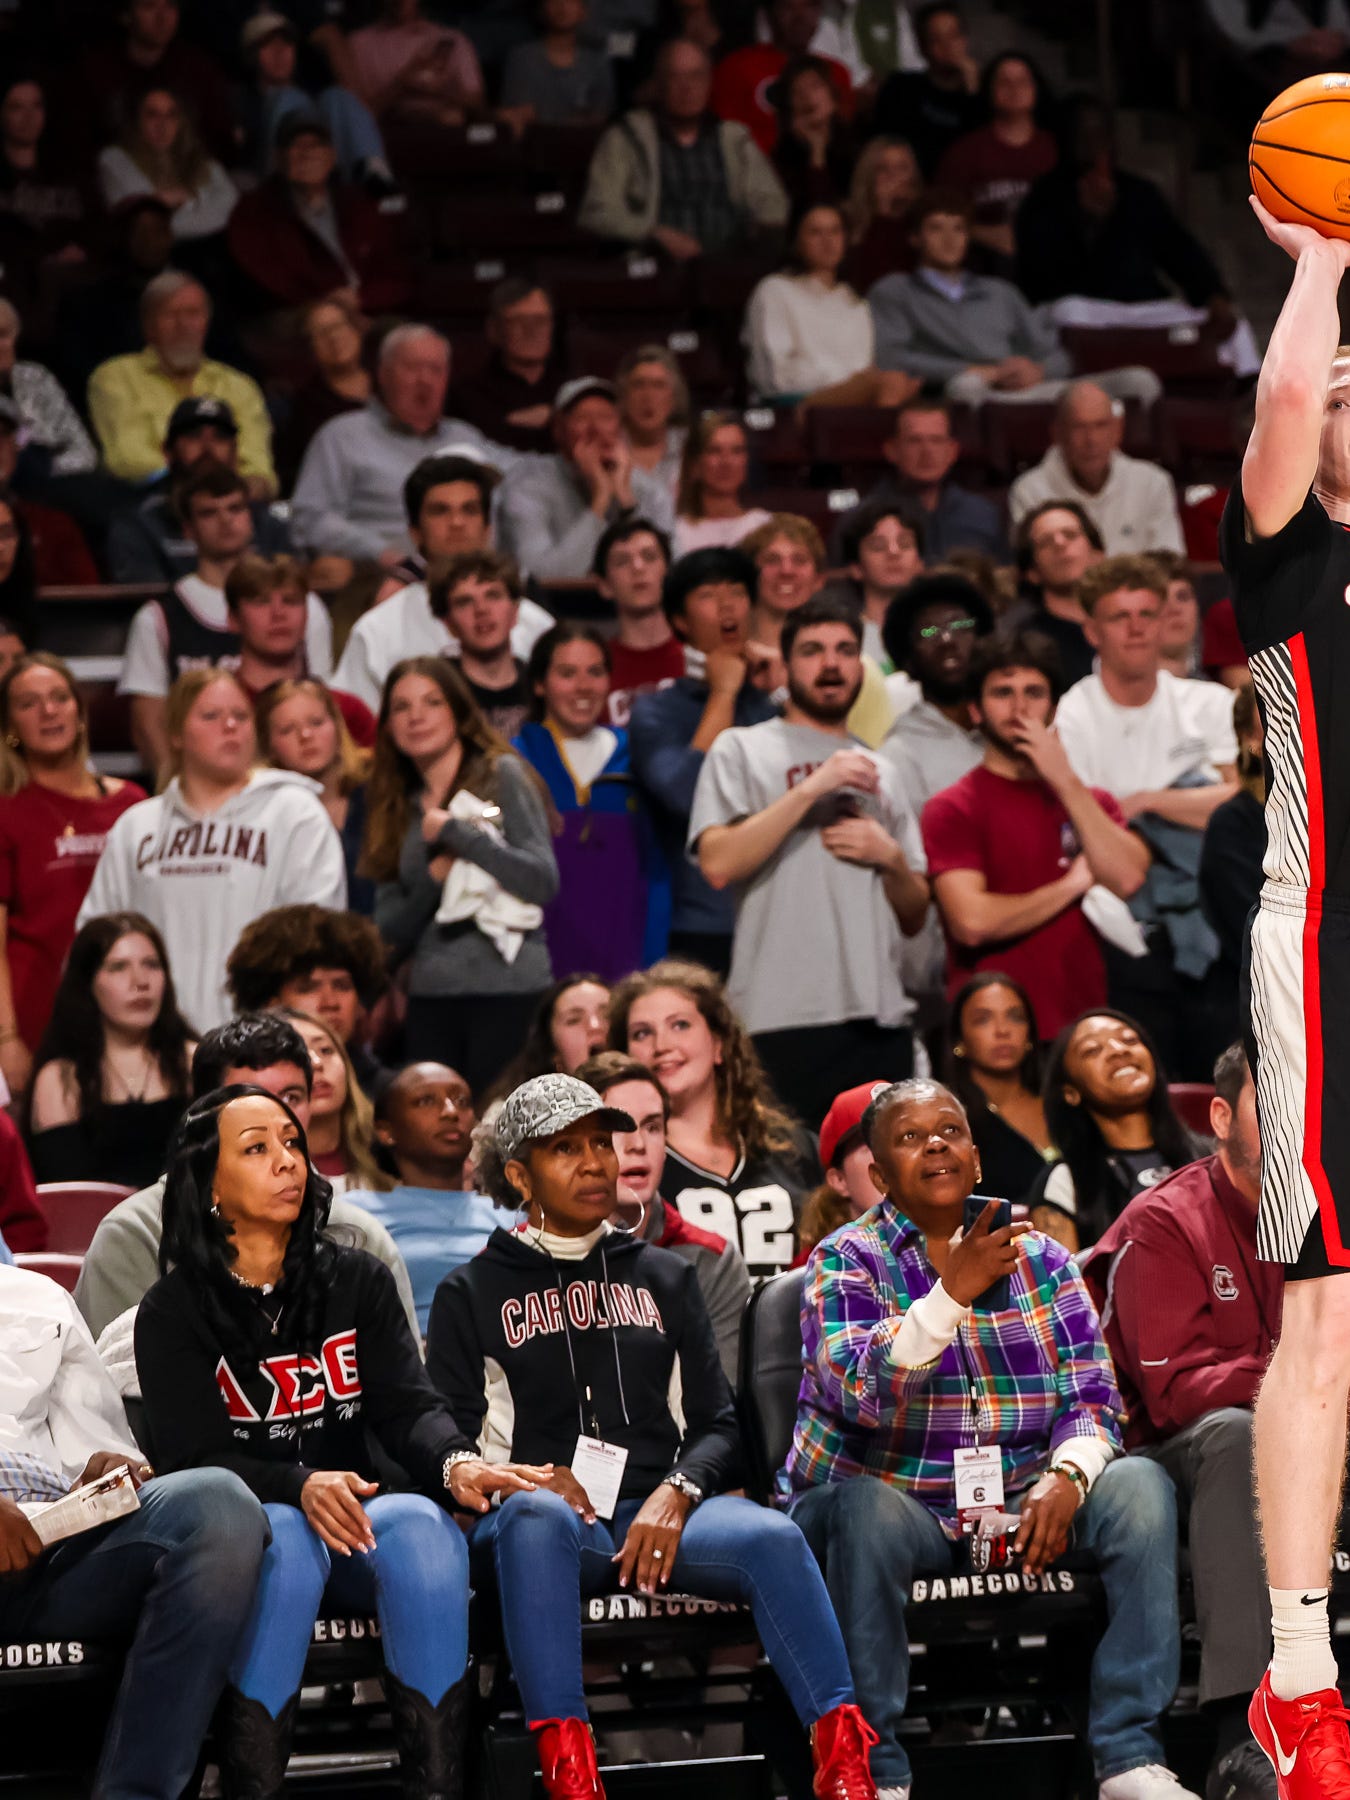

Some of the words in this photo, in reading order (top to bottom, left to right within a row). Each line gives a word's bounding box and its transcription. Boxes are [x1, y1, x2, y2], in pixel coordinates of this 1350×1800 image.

[676, 1184, 795, 1265] 92
[501, 1280, 666, 1348] CAROLINA
[912, 1571, 1075, 1602] GAMECOCKS
[0, 1641, 84, 1667] OCKS
